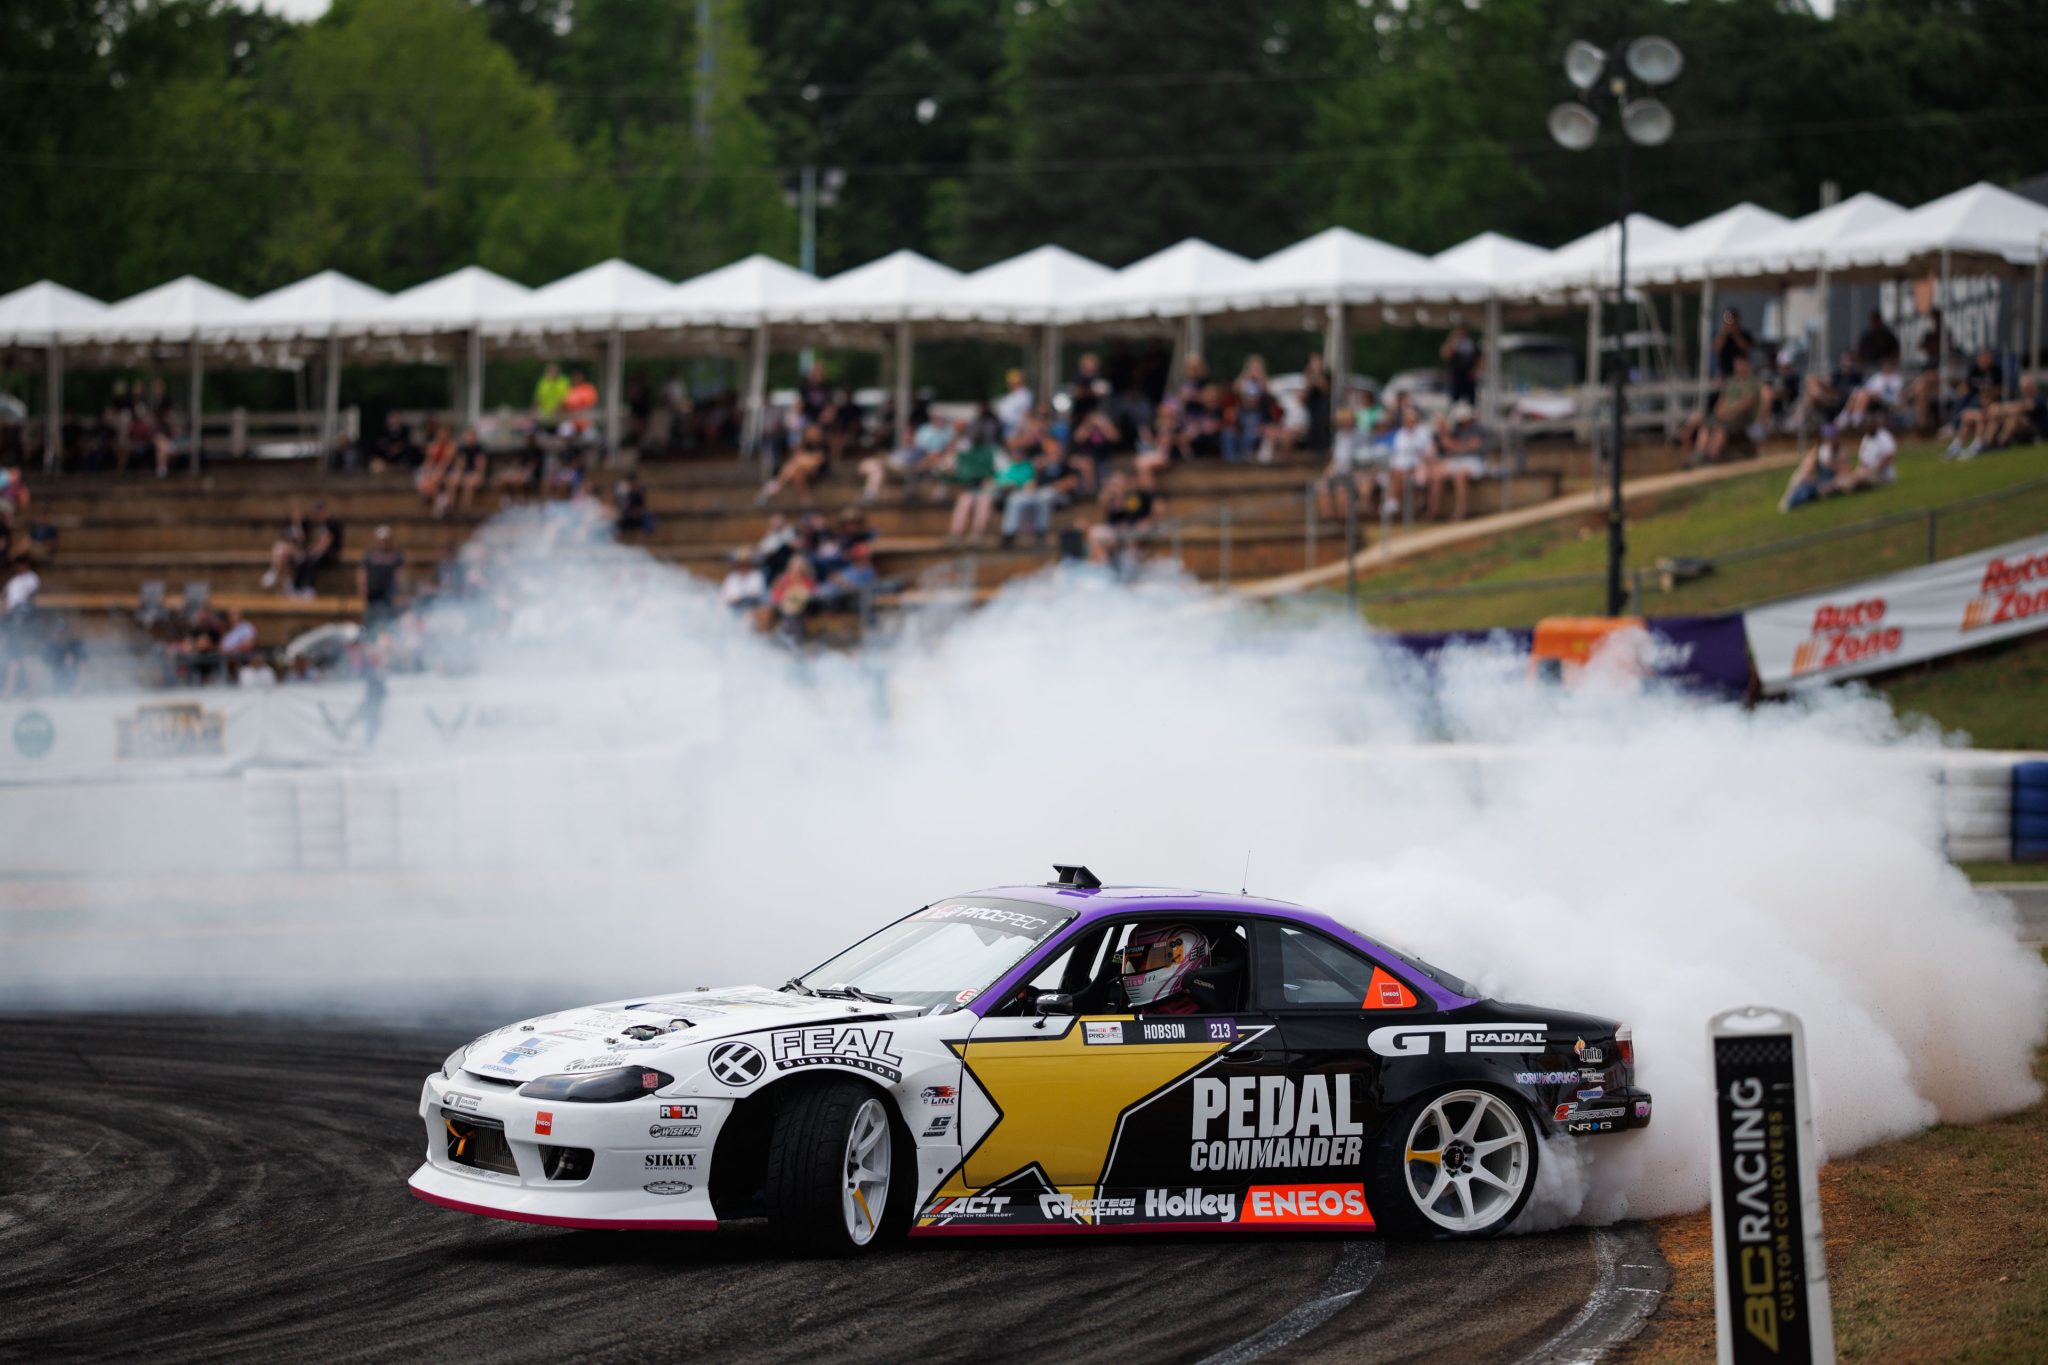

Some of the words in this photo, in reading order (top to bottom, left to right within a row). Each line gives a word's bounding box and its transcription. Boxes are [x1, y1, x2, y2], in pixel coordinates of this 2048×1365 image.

[1811, 598, 1887, 635] Auto
[1992, 590, 2048, 624] Zon
[1820, 626, 1902, 669] Zone
[956, 906, 1048, 930] PROSPEC
[771, 1028, 903, 1067] FEAL
[1143, 1023, 1186, 1040] HOBSON
[1210, 1023, 1231, 1039] 213
[1367, 1023, 1548, 1057] GT
[1470, 1033, 1547, 1043] RADIAL
[783, 1057, 896, 1079] Suspension
[1192, 1073, 1364, 1140] PEDAL
[661, 1127, 700, 1136] WISEFAB
[645, 1154, 697, 1167] SIKKY
[1190, 1136, 1363, 1172] COMMANDER
[1730, 1076, 1771, 1242] RACING
[1769, 1110, 1789, 1228] COILOVERS
[940, 1197, 1012, 1214] ACT
[1070, 1207, 1135, 1216] RACING
[1071, 1198, 1136, 1207] MOTEGI
[1145, 1188, 1236, 1223] Holley
[1252, 1190, 1365, 1217] ENEOS
[1776, 1235, 1795, 1321] CUSTOM
